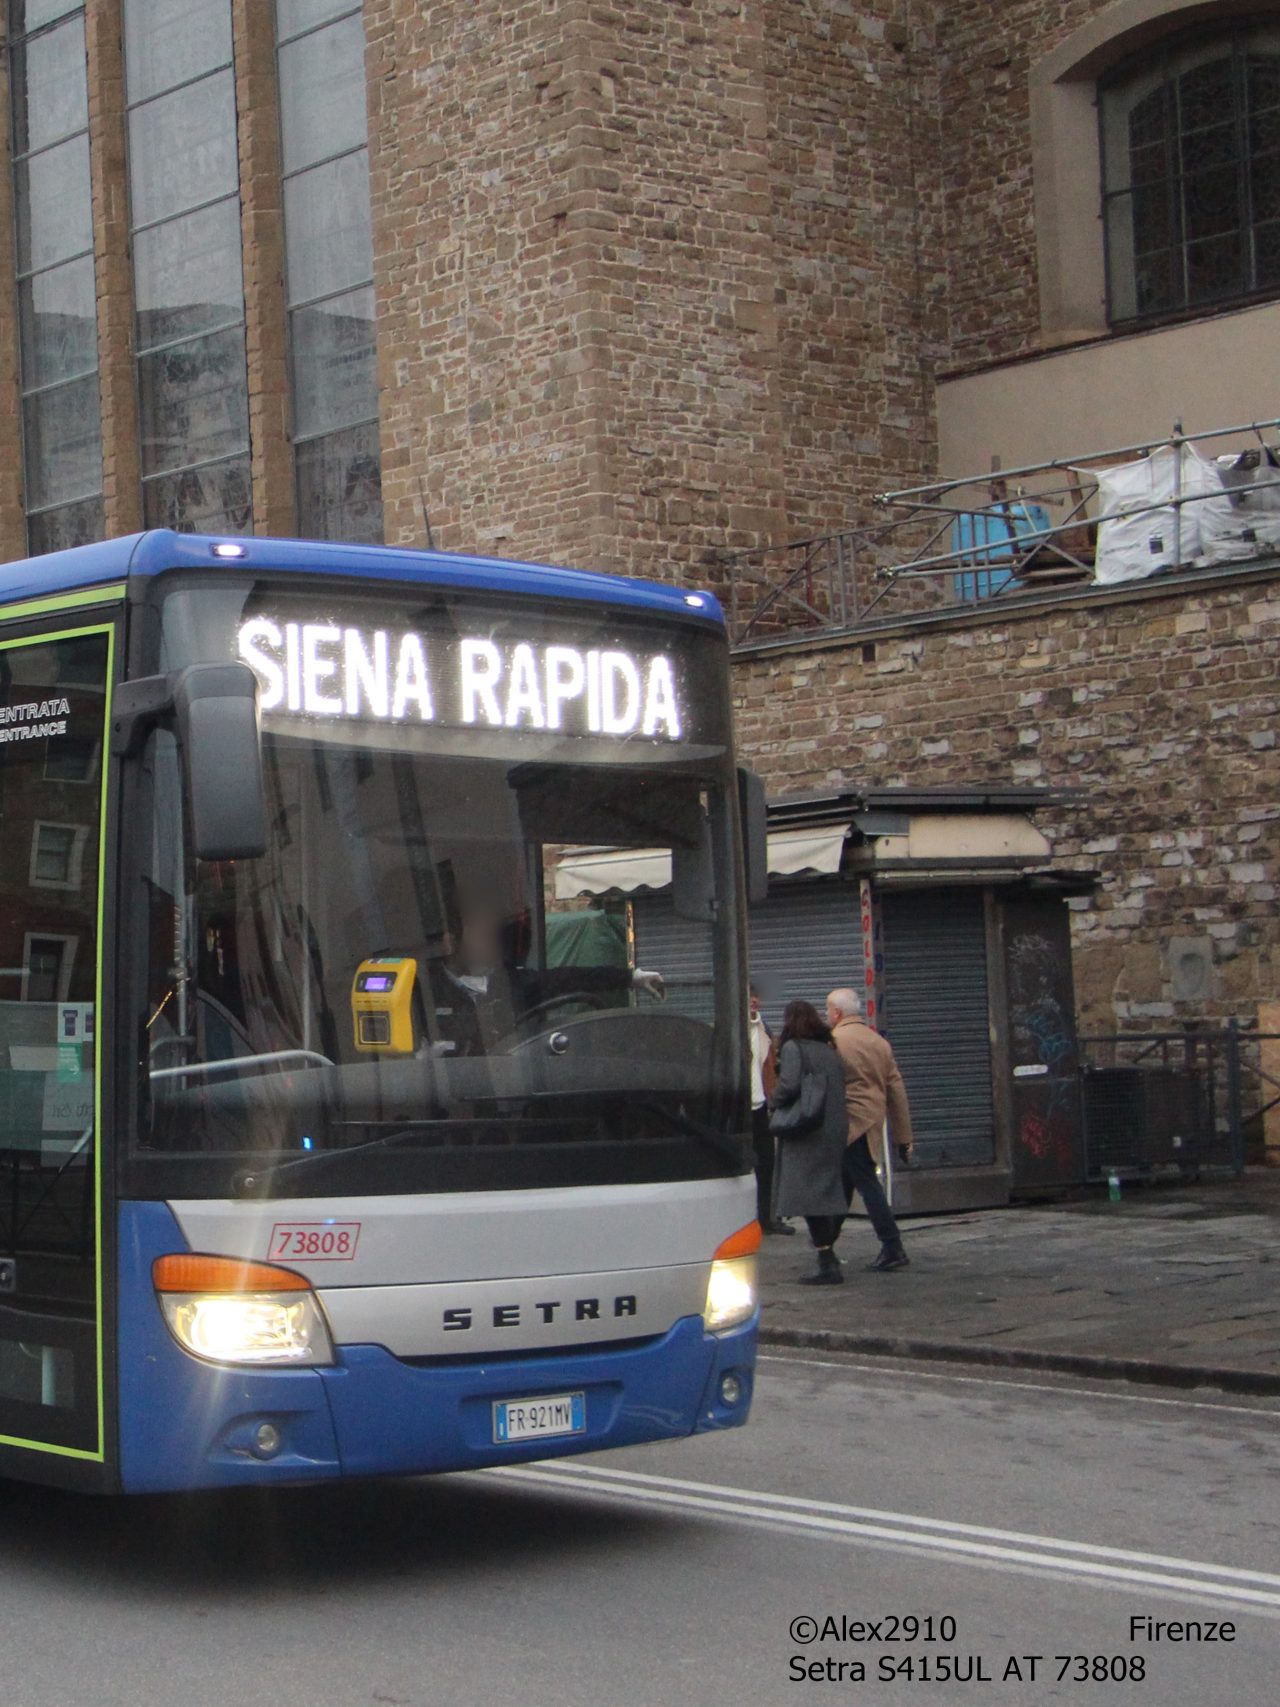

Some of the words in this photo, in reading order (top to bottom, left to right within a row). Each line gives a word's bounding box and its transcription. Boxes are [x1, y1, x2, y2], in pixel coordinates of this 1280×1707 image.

[238, 617, 434, 721] SIENA
[460, 638, 682, 738] RAPIDA
[278, 1231, 350, 1254] 73808
[443, 1295, 637, 1331] SETRA
